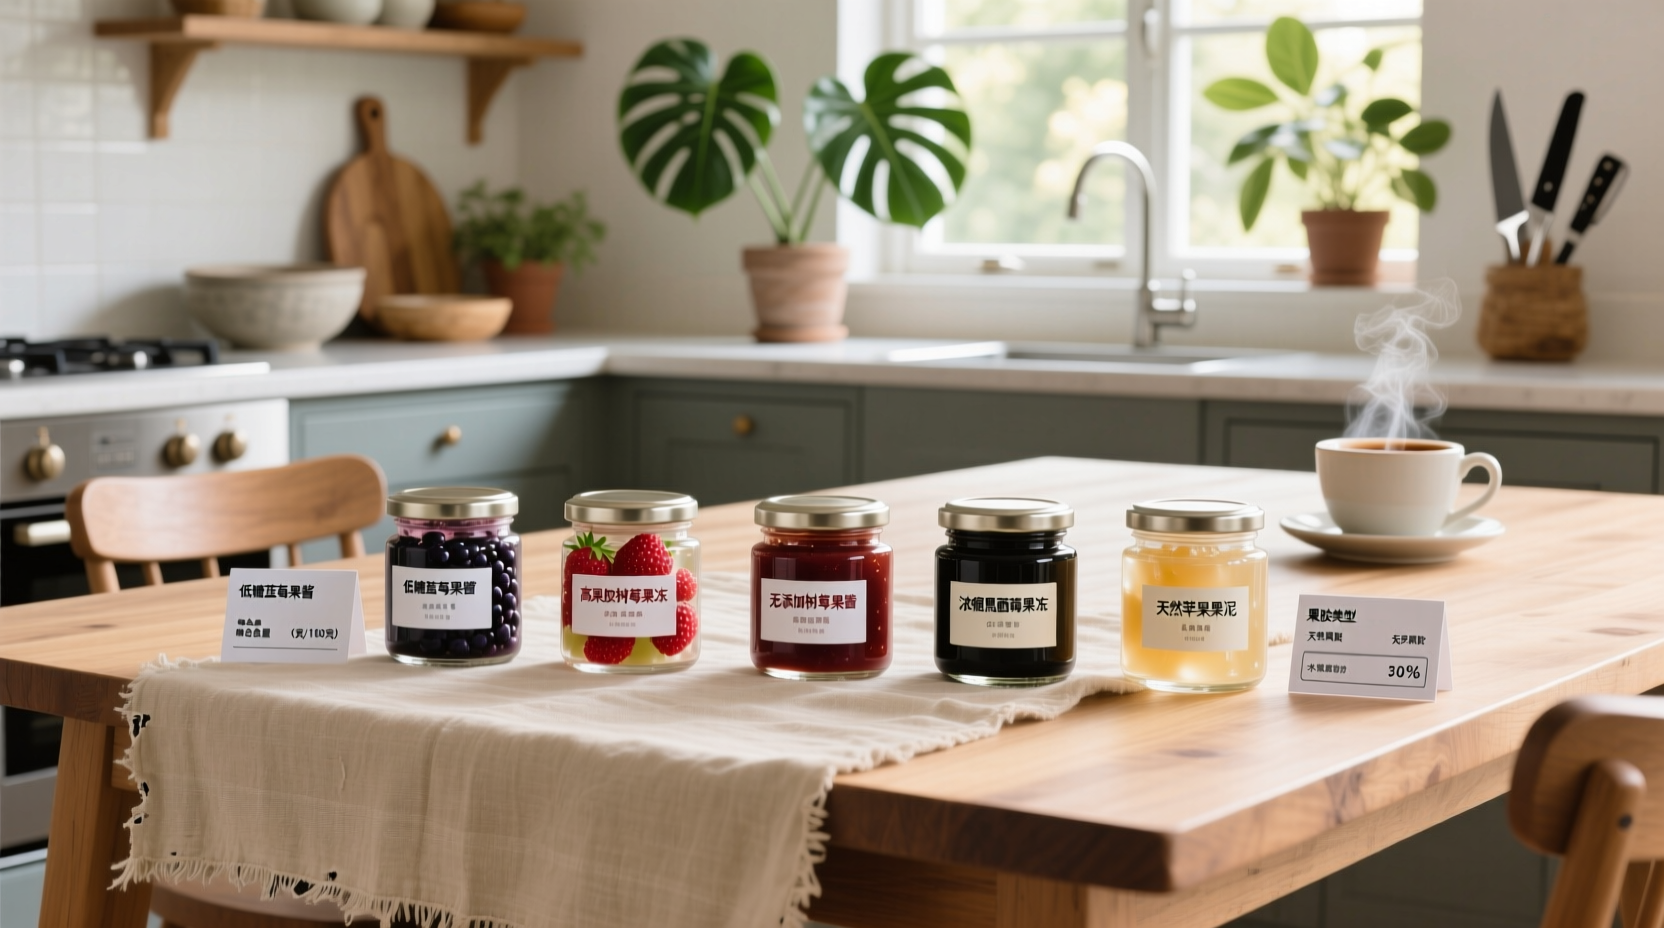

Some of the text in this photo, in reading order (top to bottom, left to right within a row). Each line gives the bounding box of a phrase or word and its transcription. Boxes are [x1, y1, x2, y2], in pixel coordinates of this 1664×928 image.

[1156, 600, 1237, 618] 天然苹果果泥
[1388, 665, 1421, 679] 30%
